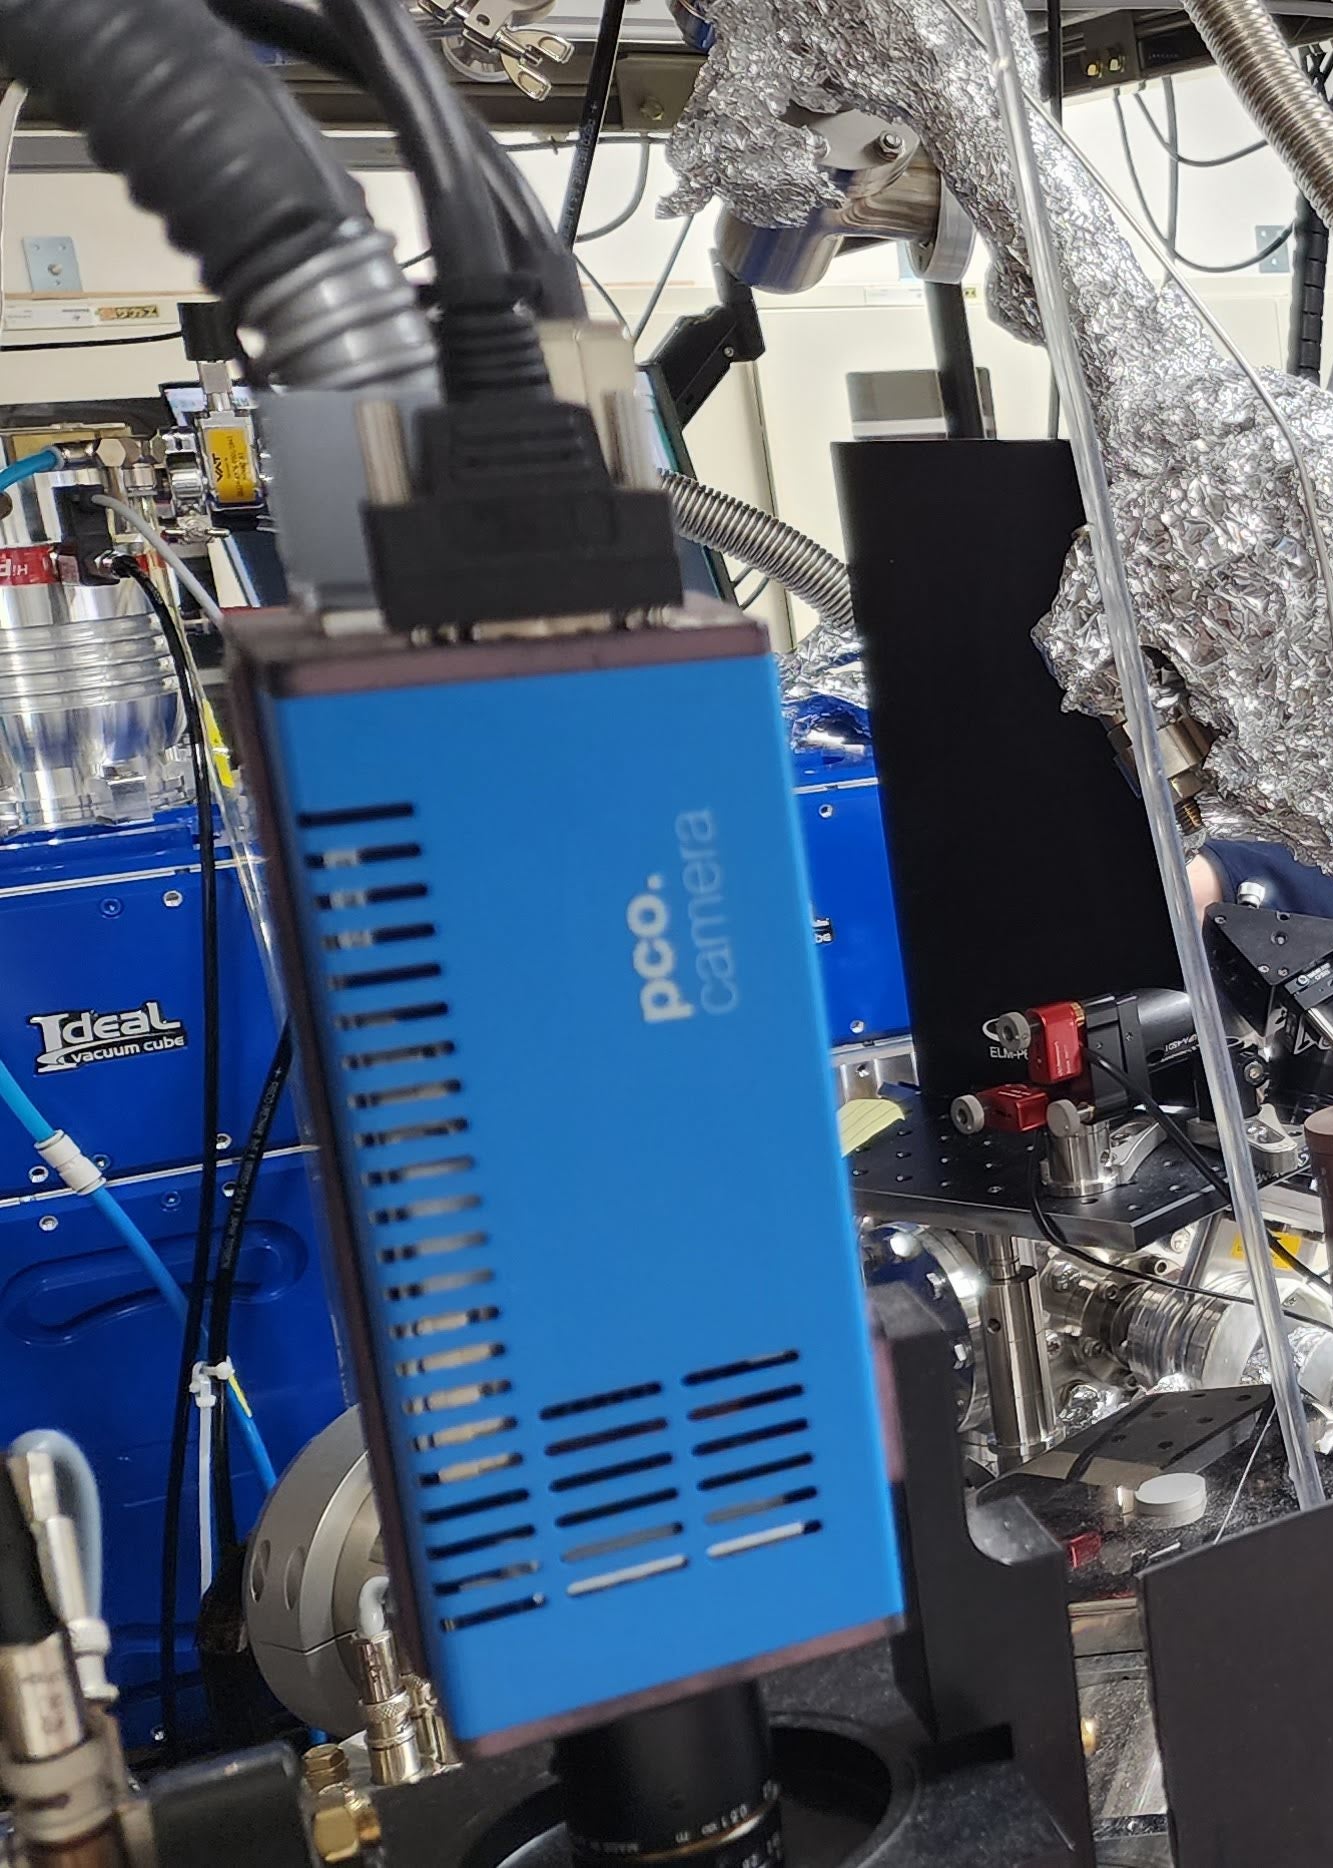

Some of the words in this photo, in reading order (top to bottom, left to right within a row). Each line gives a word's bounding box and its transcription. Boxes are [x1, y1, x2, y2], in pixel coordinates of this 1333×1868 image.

[212, 453, 223, 483] VAT
[627, 873, 694, 1024] pco.
[674, 808, 738, 1015] camera
[71, 1043, 141, 1063] vacuum
[143, 1035, 185, 1051] cube
